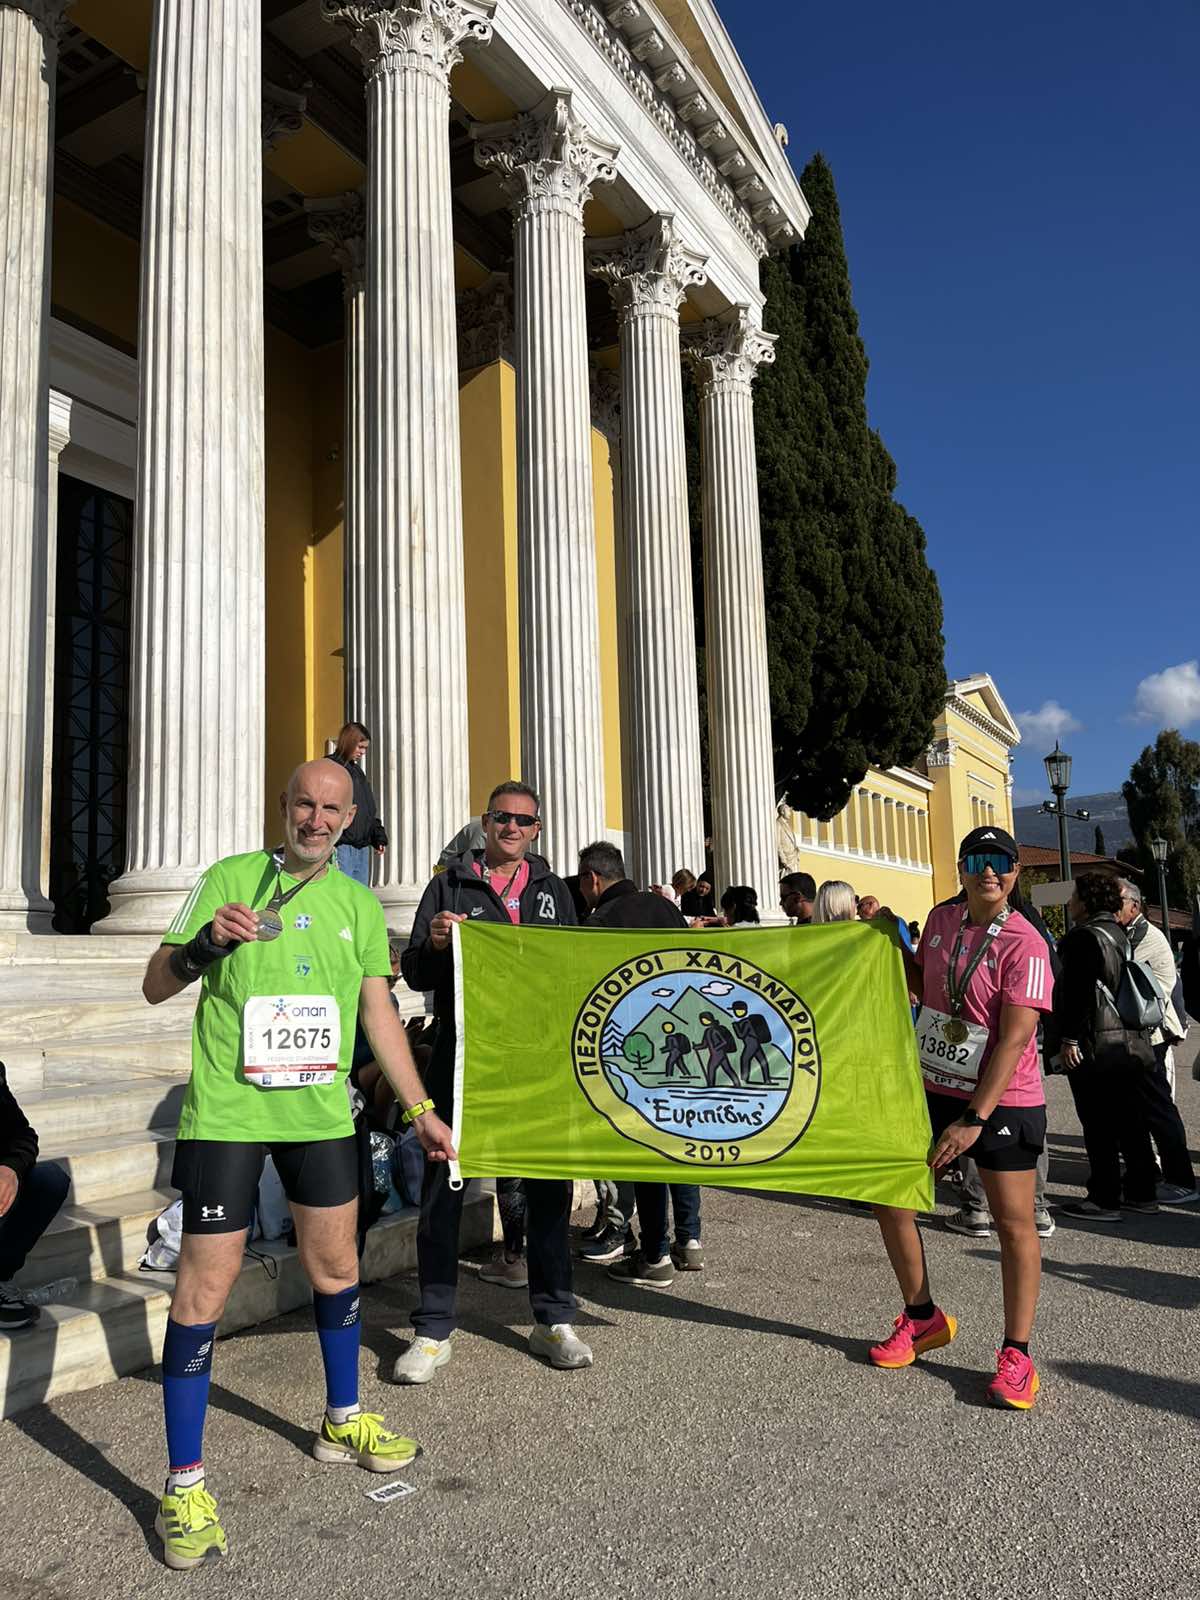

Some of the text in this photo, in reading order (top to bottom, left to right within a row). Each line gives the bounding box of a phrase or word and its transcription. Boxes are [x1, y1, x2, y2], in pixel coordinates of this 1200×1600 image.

[536, 891, 556, 920] 23
[579, 954, 664, 1077] ΠΕΖΟΠΟΡΟΙ
[685, 951, 817, 1077] ΧΑΛΑΝΔΡΙΟΥ
[262, 1028, 331, 1050] 12675
[920, 1034, 970, 1066] 13882
[684, 1142, 741, 1162] 2019
